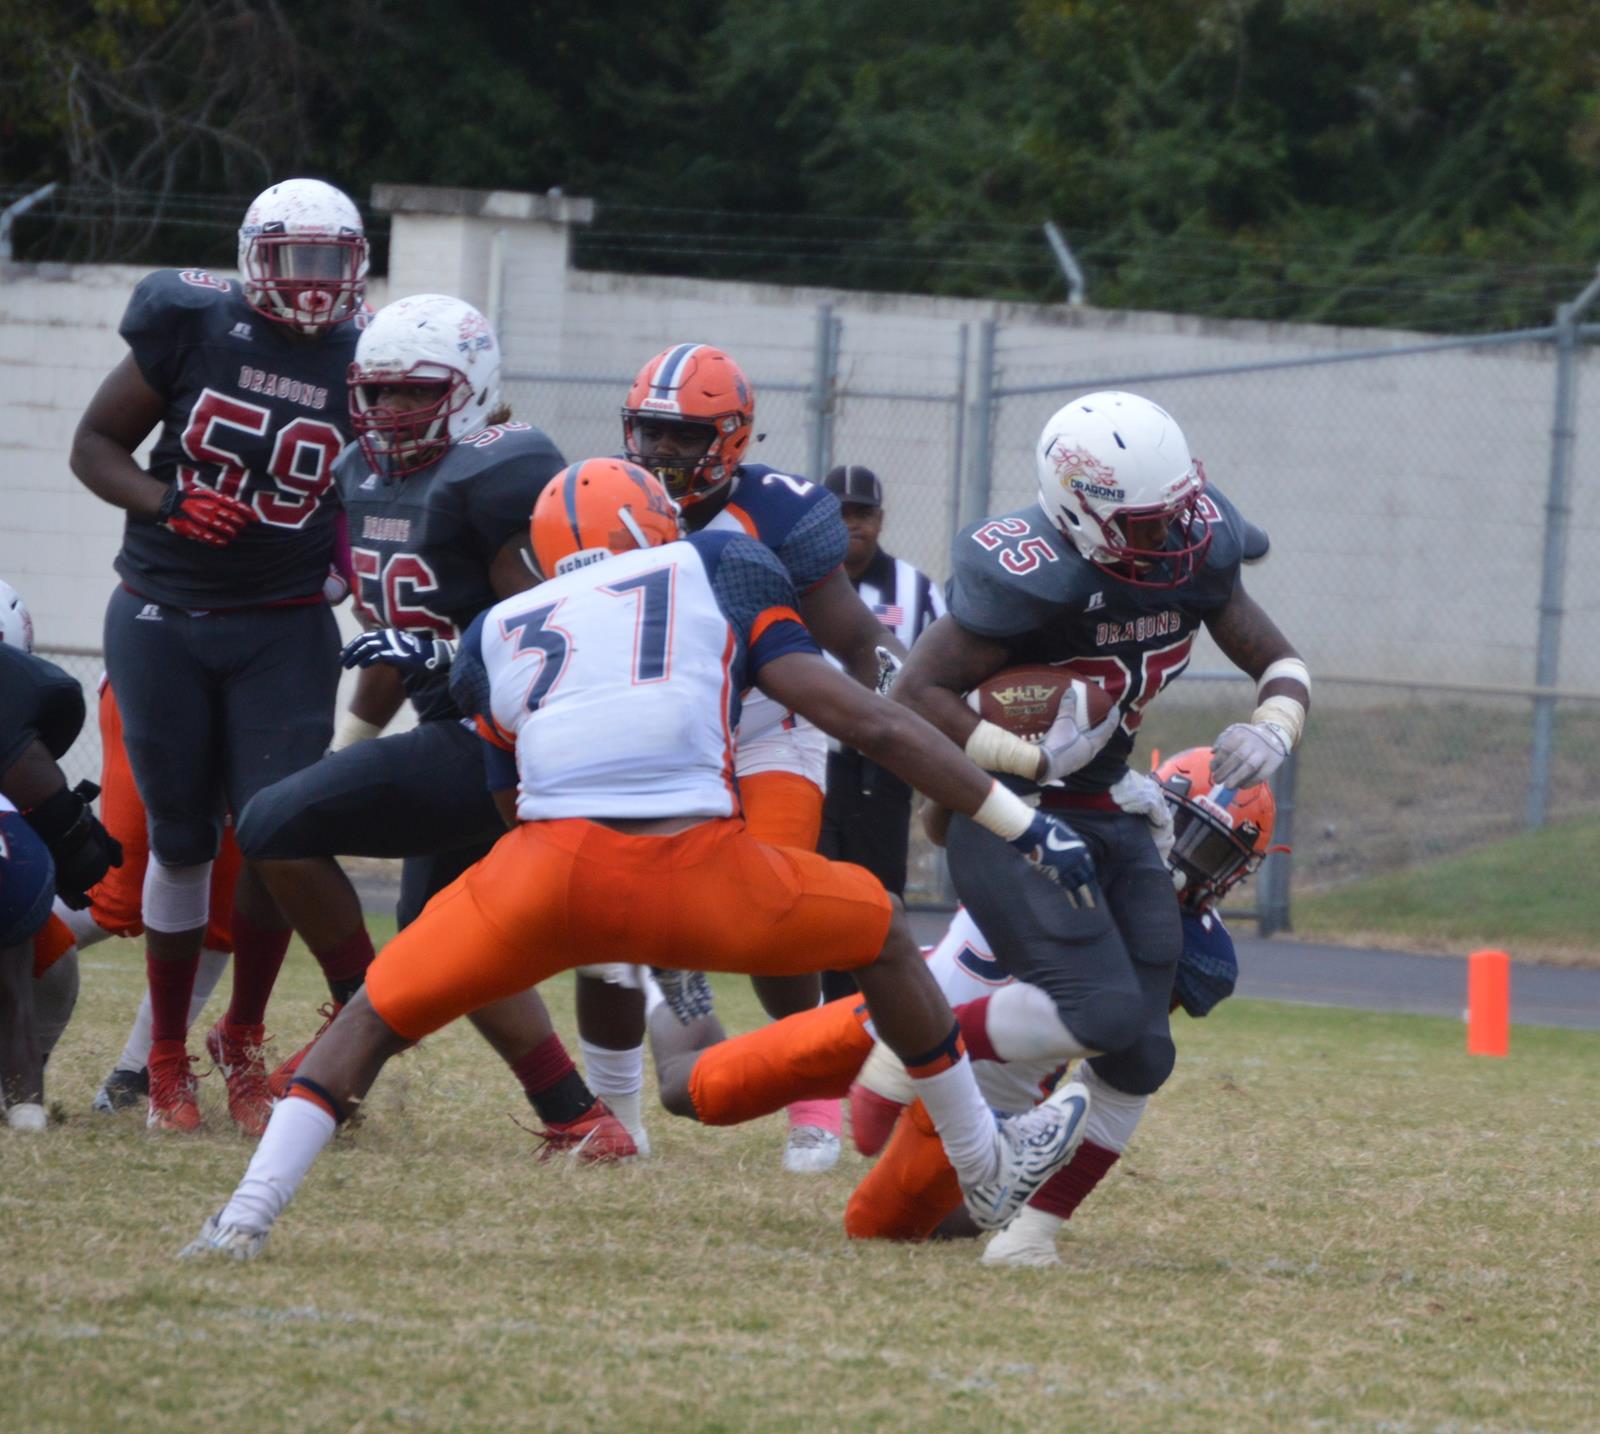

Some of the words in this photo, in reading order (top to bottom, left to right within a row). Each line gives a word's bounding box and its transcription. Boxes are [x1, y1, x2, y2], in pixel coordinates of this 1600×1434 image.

[238, 365, 328, 410] DRAGONS
[182, 388, 346, 529] 59
[558, 551, 605, 575] schutt
[973, 517, 1059, 576] 25
[351, 546, 461, 641] 56
[498, 562, 678, 714] 37
[1096, 610, 1181, 646] DRAGONS
